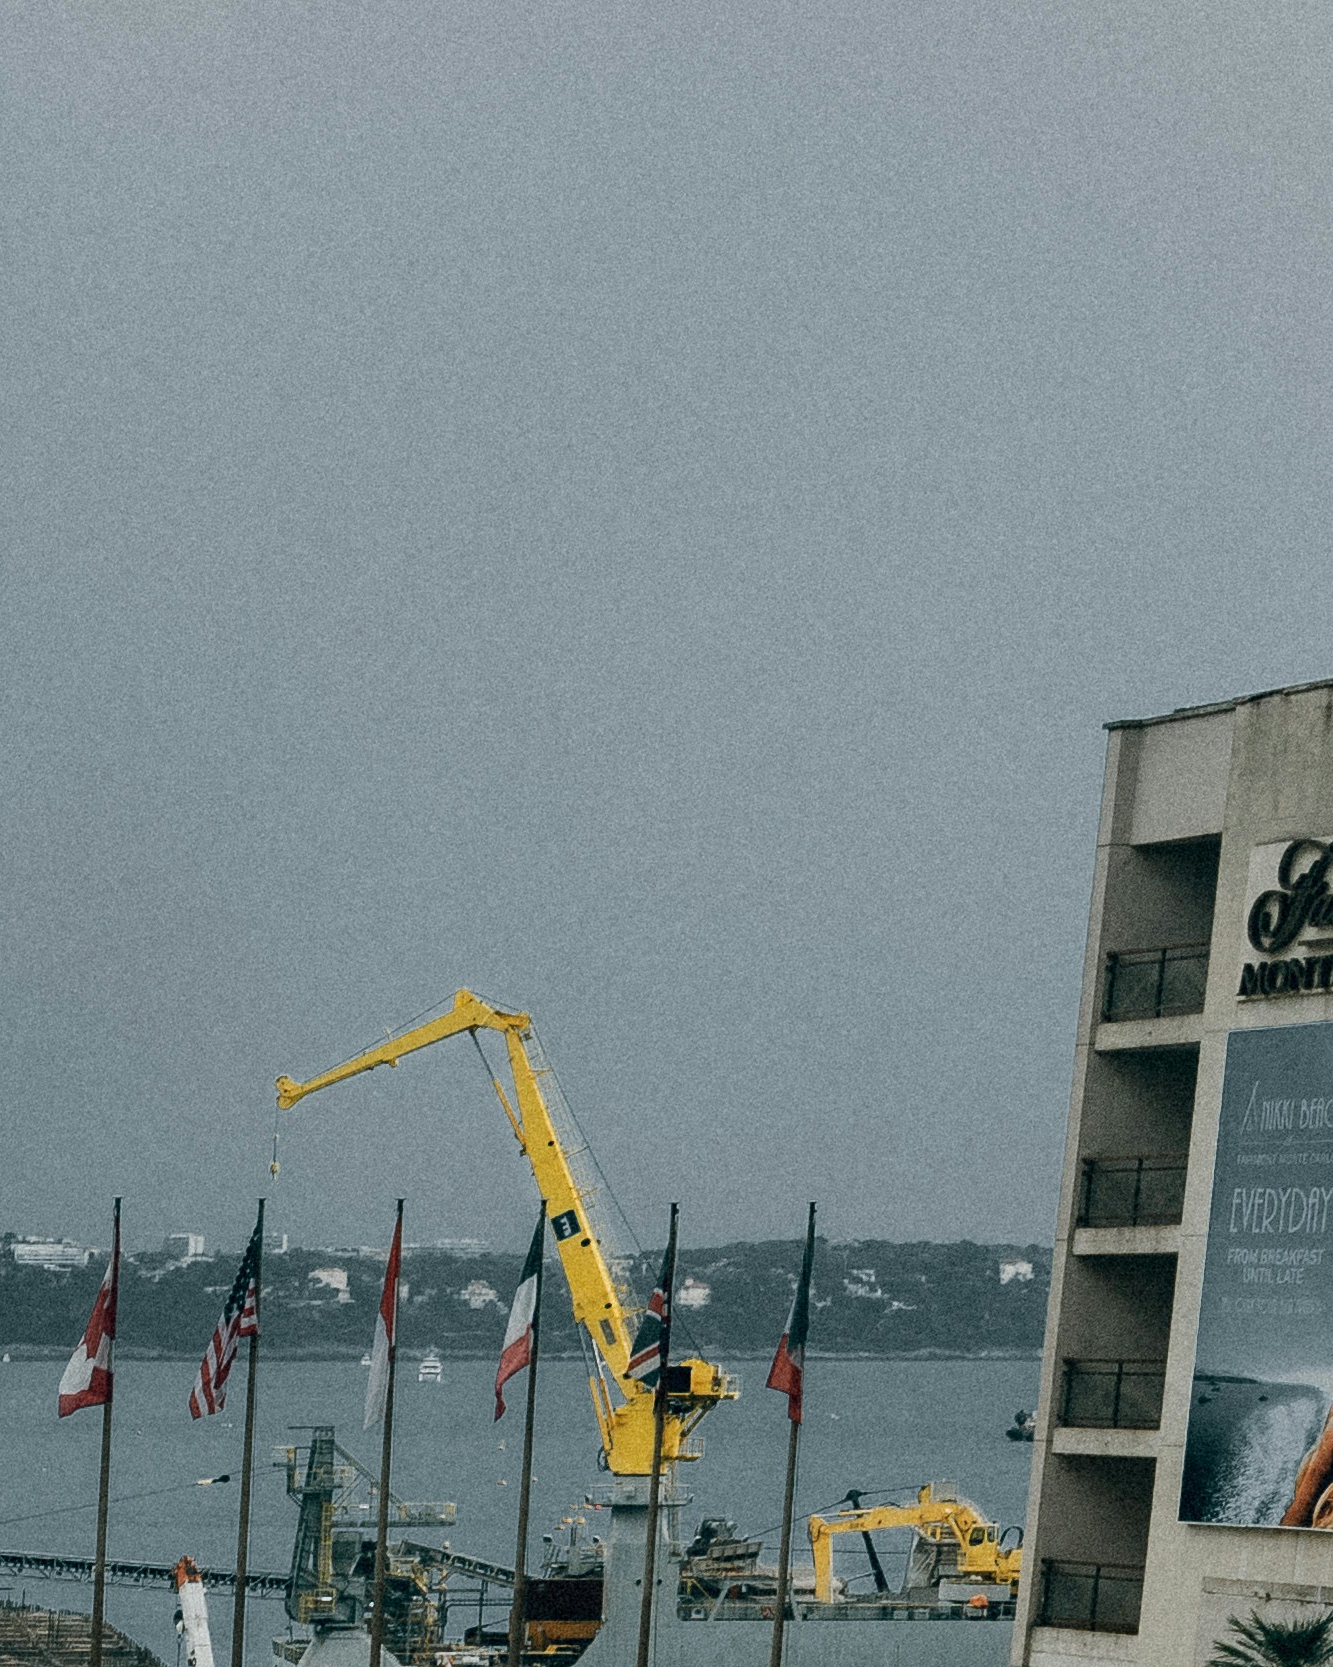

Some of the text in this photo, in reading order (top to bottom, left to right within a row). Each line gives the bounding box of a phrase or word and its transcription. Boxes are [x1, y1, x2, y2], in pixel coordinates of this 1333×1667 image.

[1260, 1100, 1295, 1131] NIKKI
[1229, 1186, 1333, 1233] EVERYDAY
[1227, 1248, 1325, 1265] FROM BREAKFAST
[1242, 1267, 1304, 1284] UNTIL LATE
